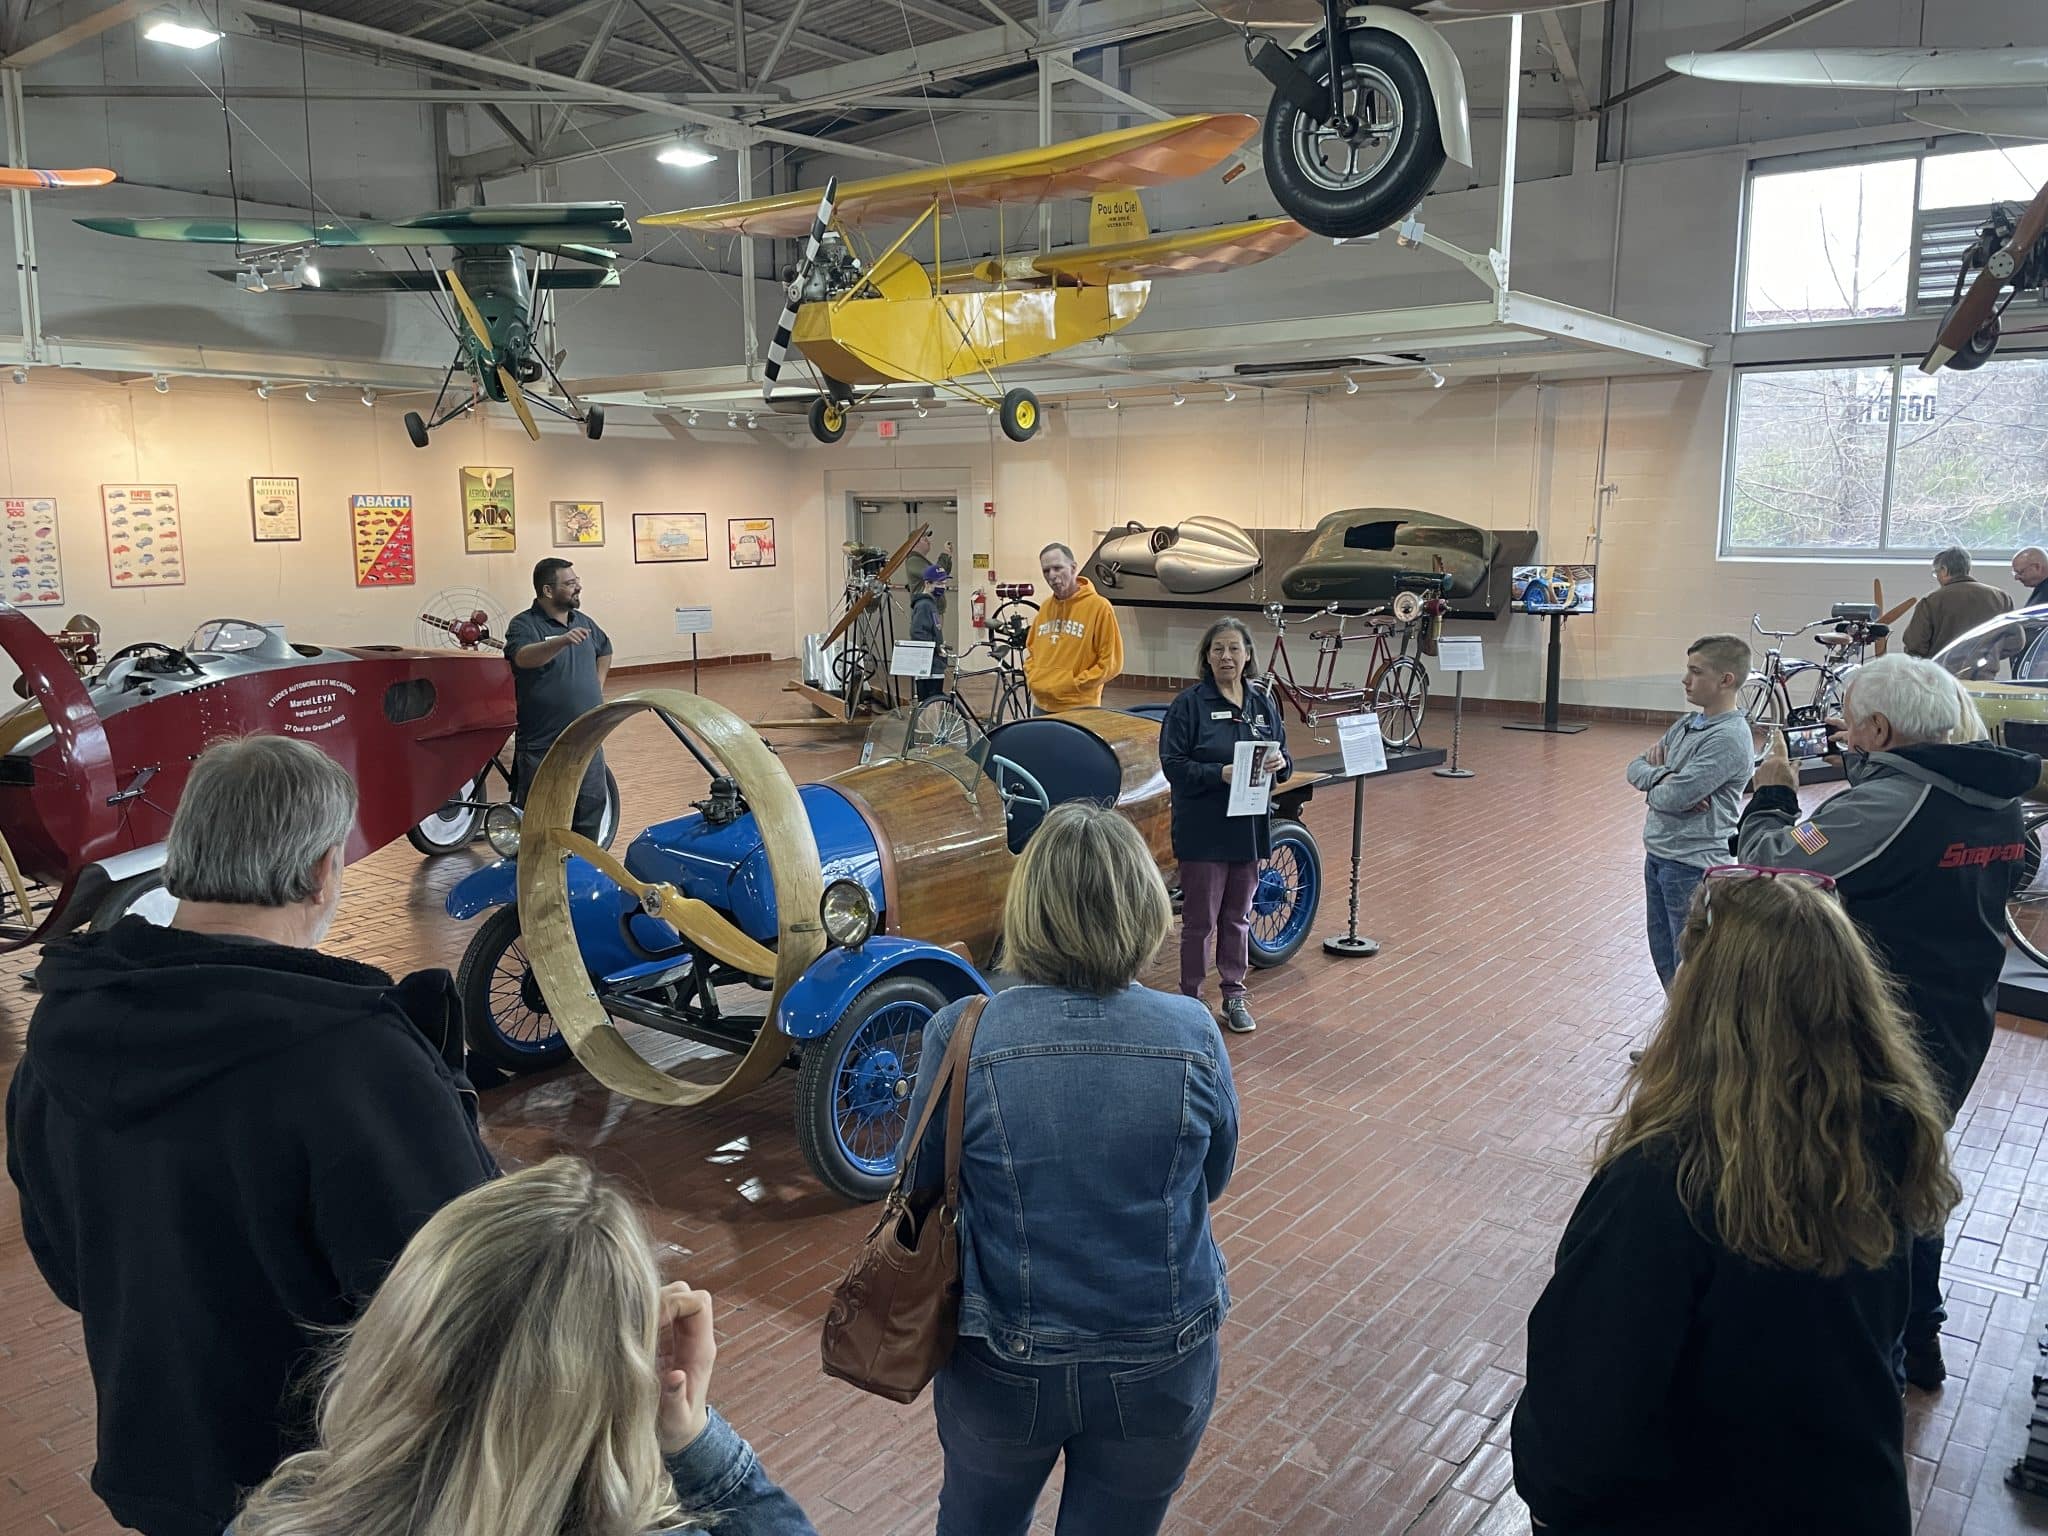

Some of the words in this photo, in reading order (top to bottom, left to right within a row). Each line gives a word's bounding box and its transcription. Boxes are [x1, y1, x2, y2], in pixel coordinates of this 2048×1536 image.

[1097, 203, 1111, 214] Pou
[1114, 202, 1122, 213] du
[1124, 200, 1137, 213] Ciel
[357, 496, 410, 508] ABARTH
[7, 508, 25, 518] 500
[267, 688, 288, 708] ETUDES
[288, 679, 320, 692] AUTOMOBILE
[329, 679, 356, 696] MECANIQUE
[289, 697, 312, 708] Marcel
[312, 693, 337, 705] LEYAT
[284, 723, 292, 731] 27
[292, 725, 304, 733] Quai
[331, 714, 346, 725] PARIS
